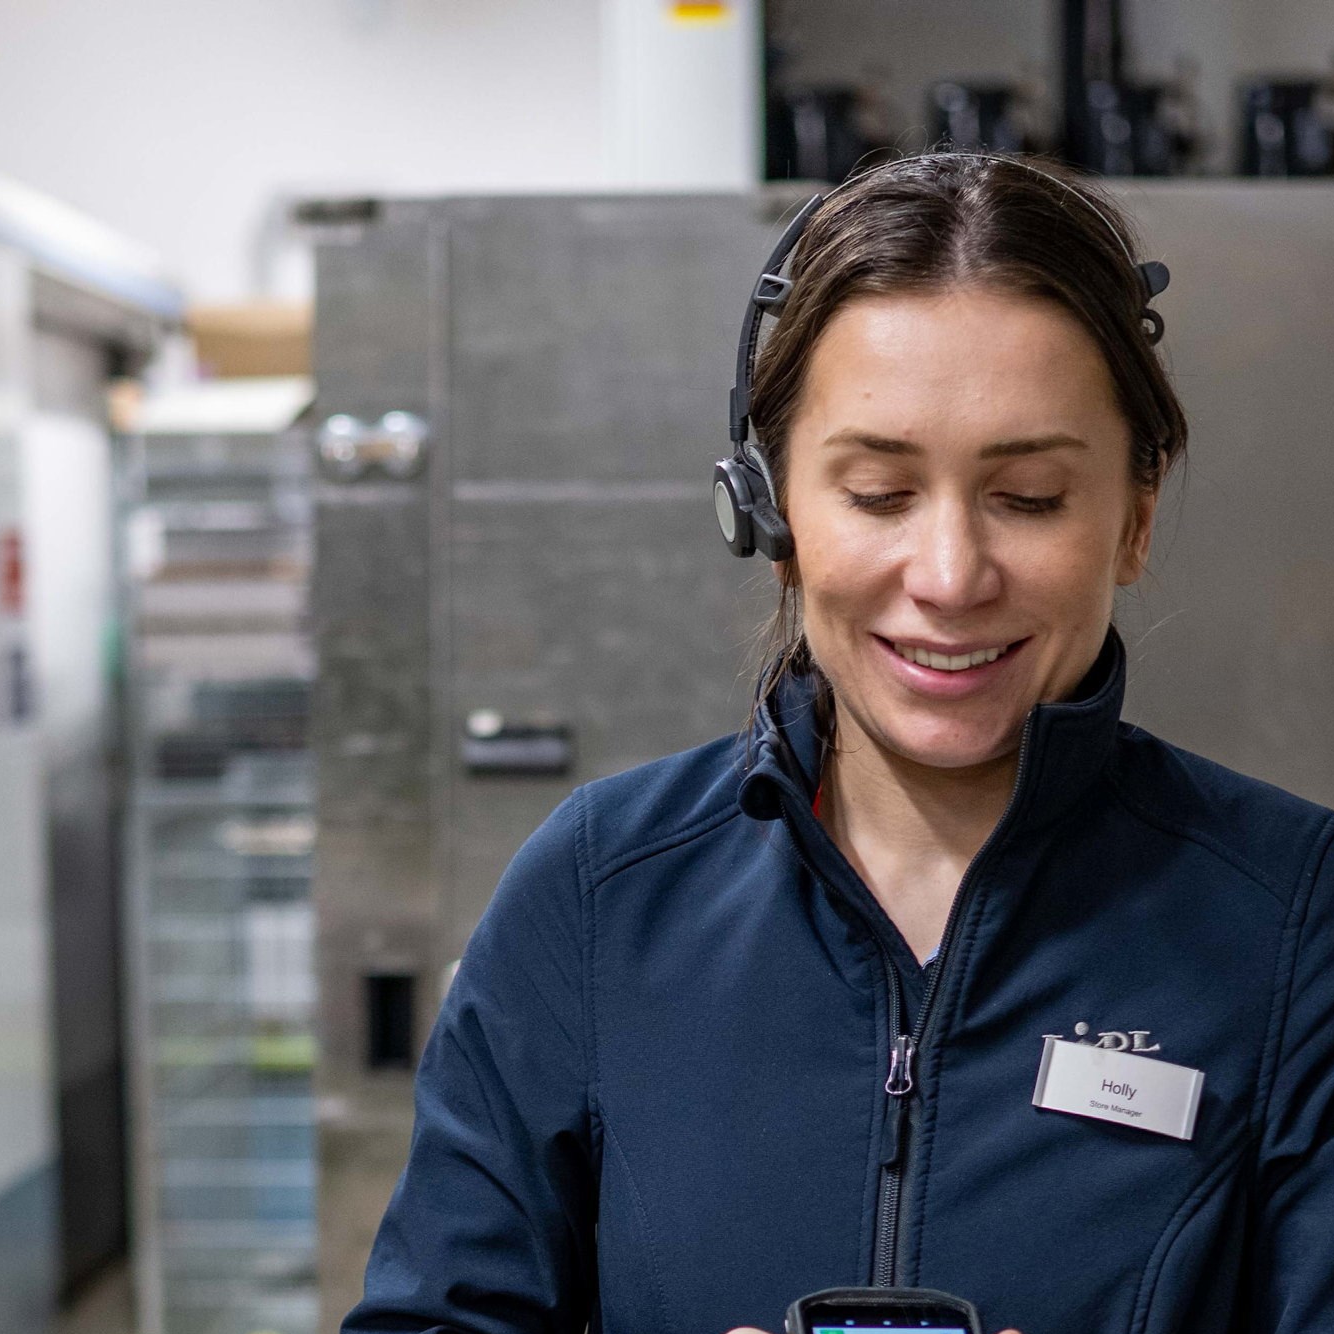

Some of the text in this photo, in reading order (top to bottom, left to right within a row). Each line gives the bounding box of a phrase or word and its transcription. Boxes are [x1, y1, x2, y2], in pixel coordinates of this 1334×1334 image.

[1041, 1021, 1161, 1051] DL
[1101, 1079, 1137, 1101] Holly
[1090, 1100, 1143, 1118] Store Manager
